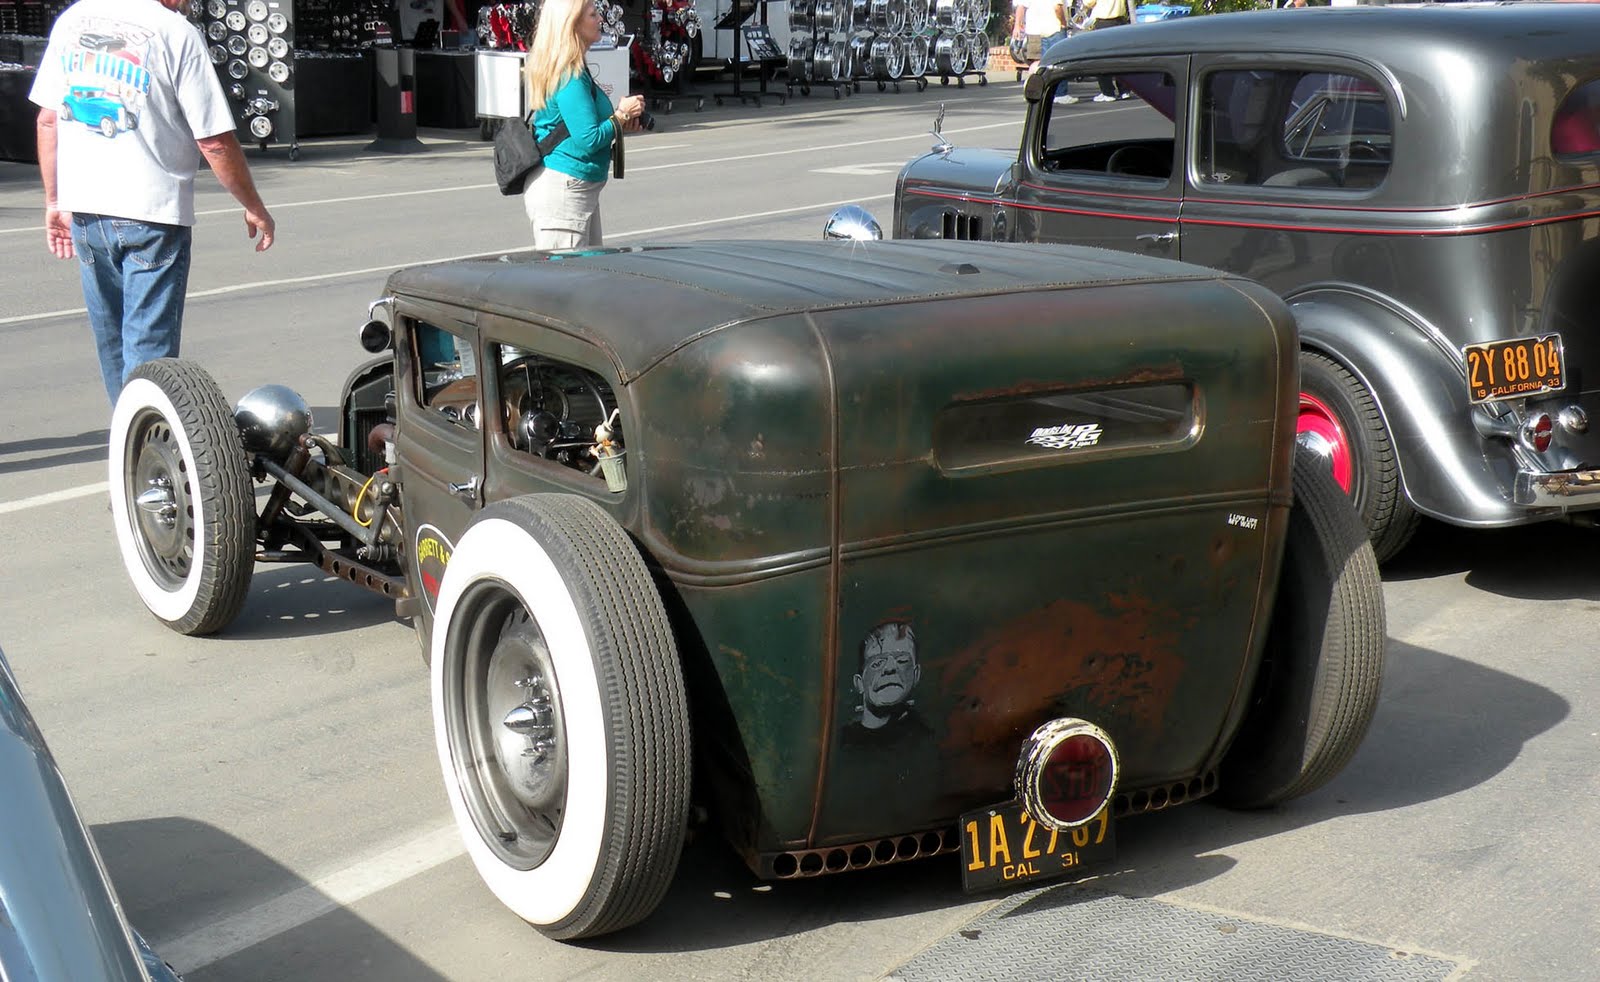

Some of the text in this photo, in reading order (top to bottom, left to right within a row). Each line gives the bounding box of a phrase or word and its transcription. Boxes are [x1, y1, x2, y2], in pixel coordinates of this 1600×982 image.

[1468, 340, 1560, 388] 2Y 88 04
[1477, 378, 1560, 398] 19 CALIFORNIA 33
[966, 814, 1011, 871] 1A
[1003, 851, 1079, 880] CAL 31
